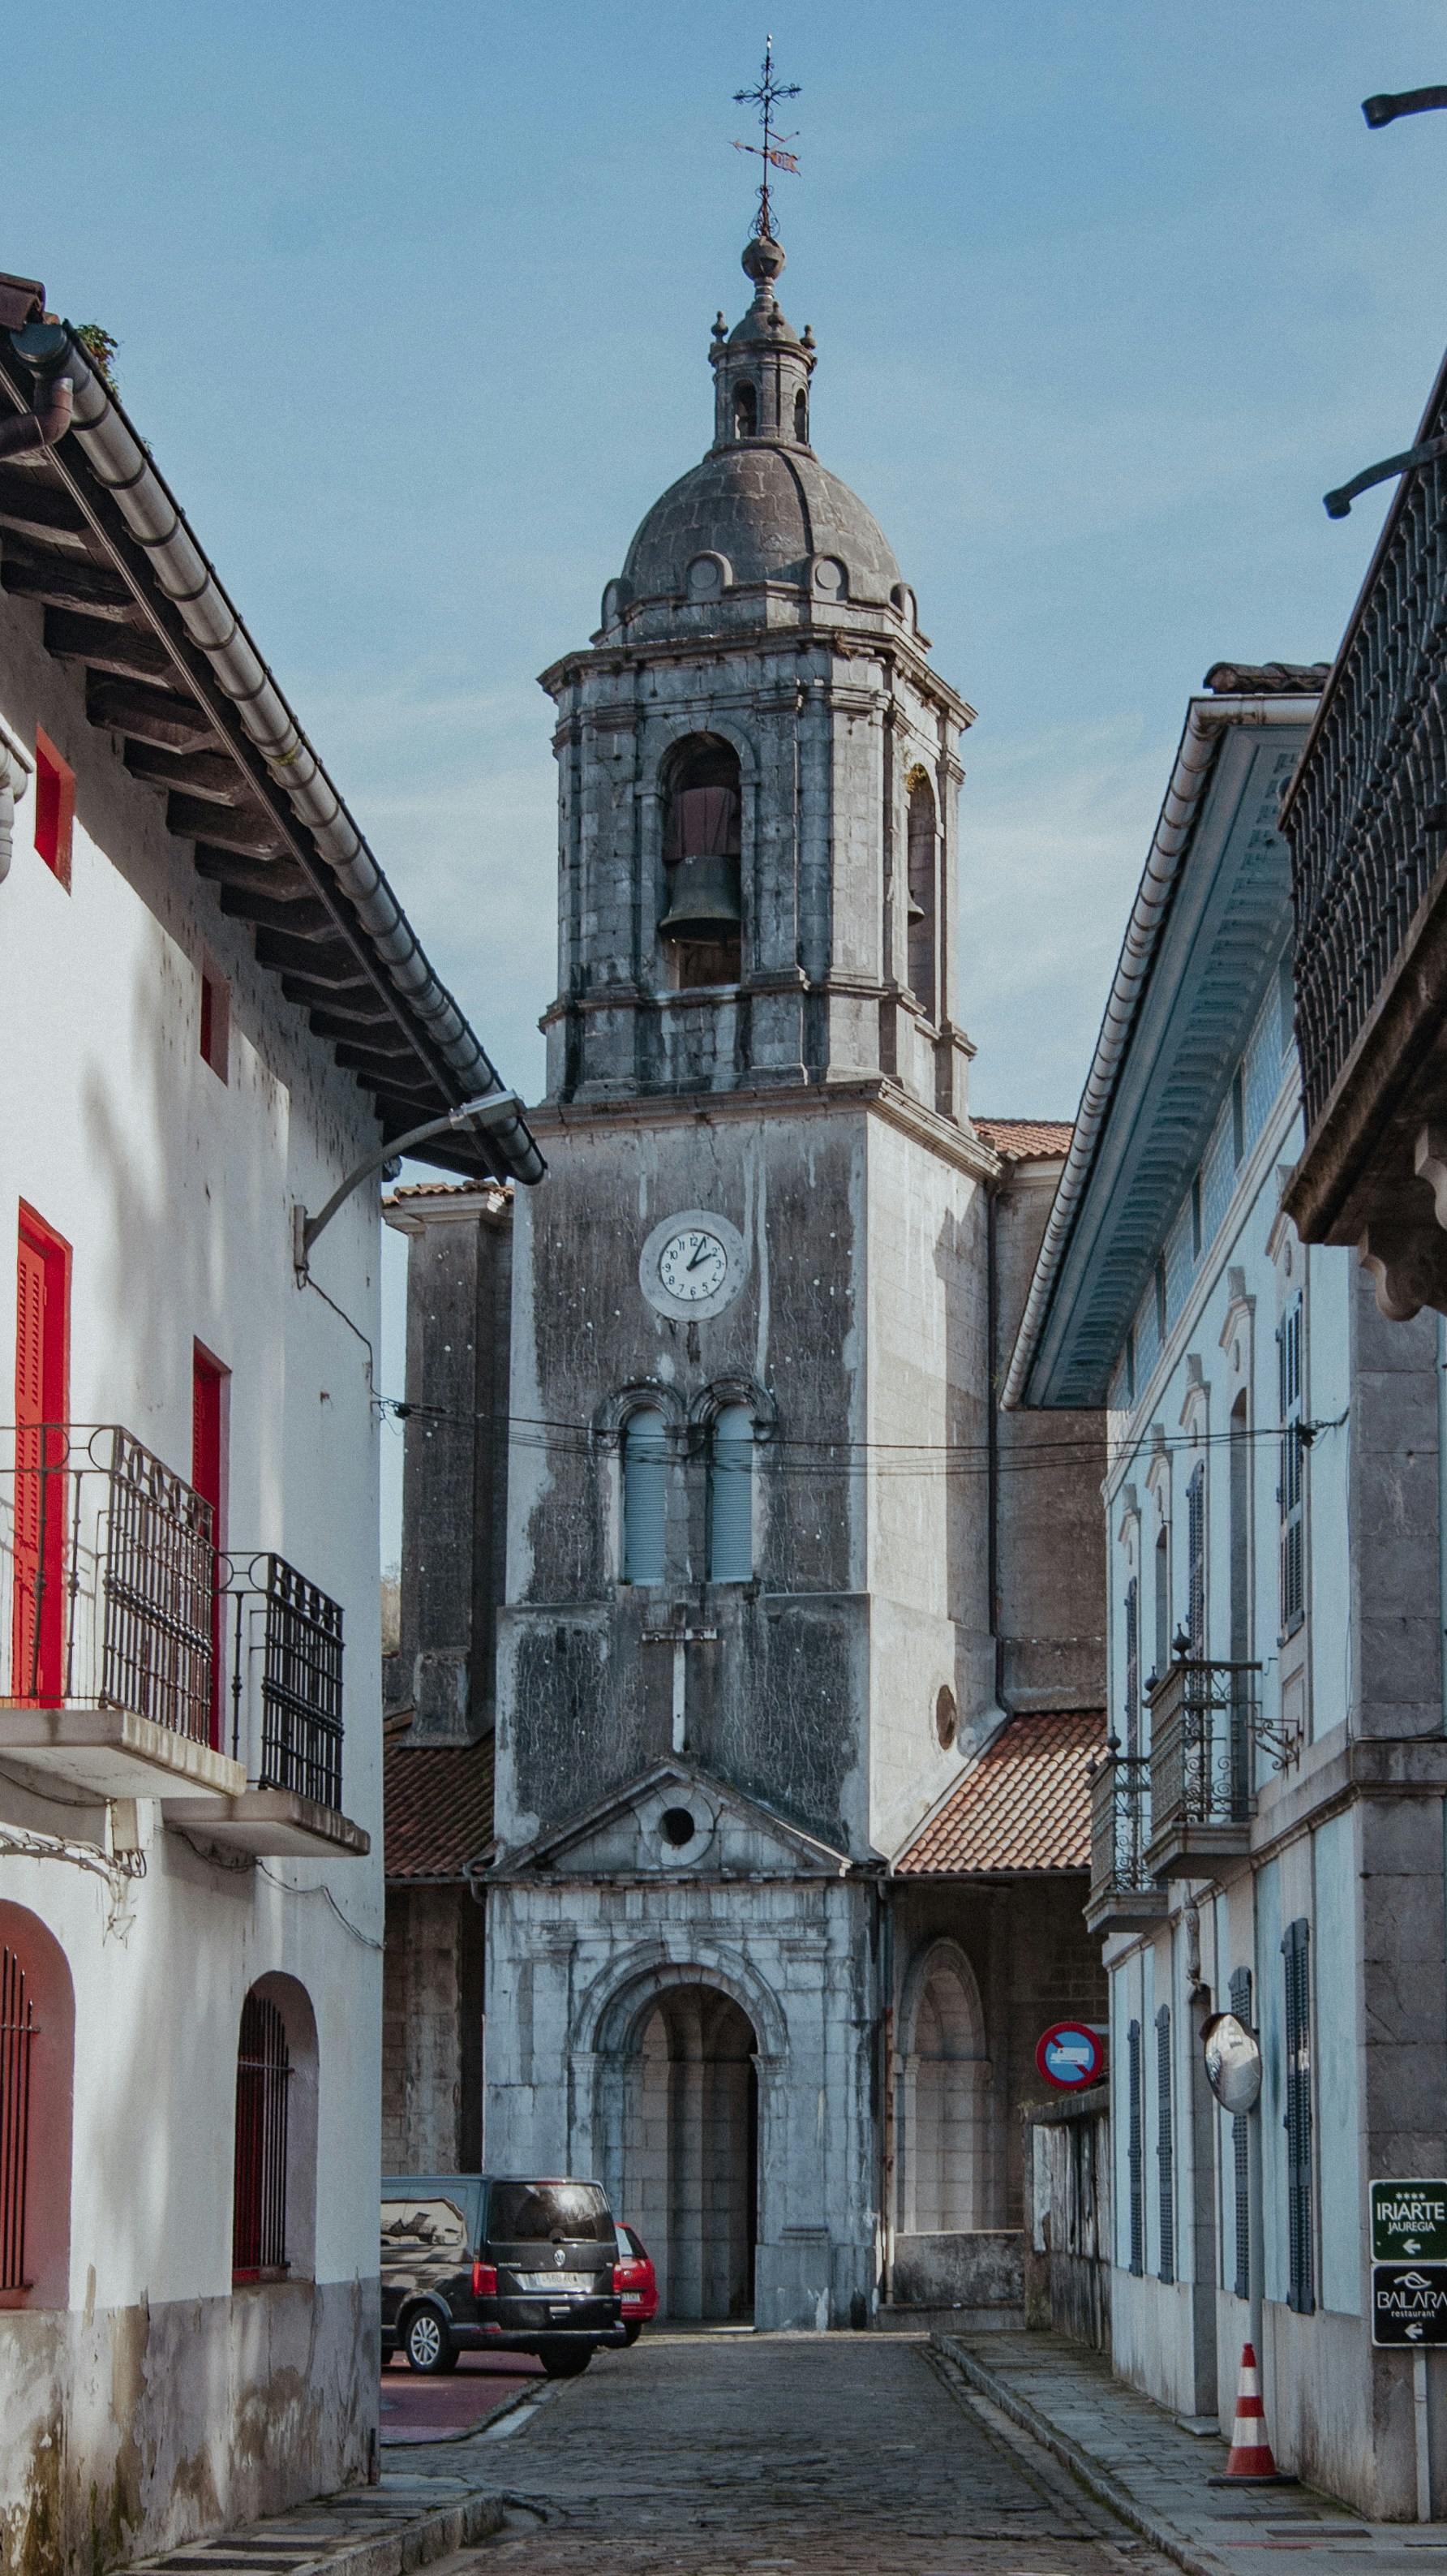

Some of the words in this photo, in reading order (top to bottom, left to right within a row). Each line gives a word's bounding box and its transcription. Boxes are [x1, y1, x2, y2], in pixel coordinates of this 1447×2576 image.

[678, 1240, 685, 1251] 11
[689, 1236, 700, 1247] 12
[669, 1250, 679, 1260] 10
[711, 1247, 718, 1257] 2
[665, 1262, 672, 1272] 9
[715, 1259, 722, 1270] 3
[668, 1275, 676, 1285] 8
[679, 1284, 685, 1293] 7
[689, 1286, 697, 1297] 6
[702, 1282, 708, 1292] 5
[1376, 2202, 1445, 2221] IRIARTE
[1387, 2221, 1436, 2235] JAUREGIA
[1391, 2310, 1436, 2318] restaurant
